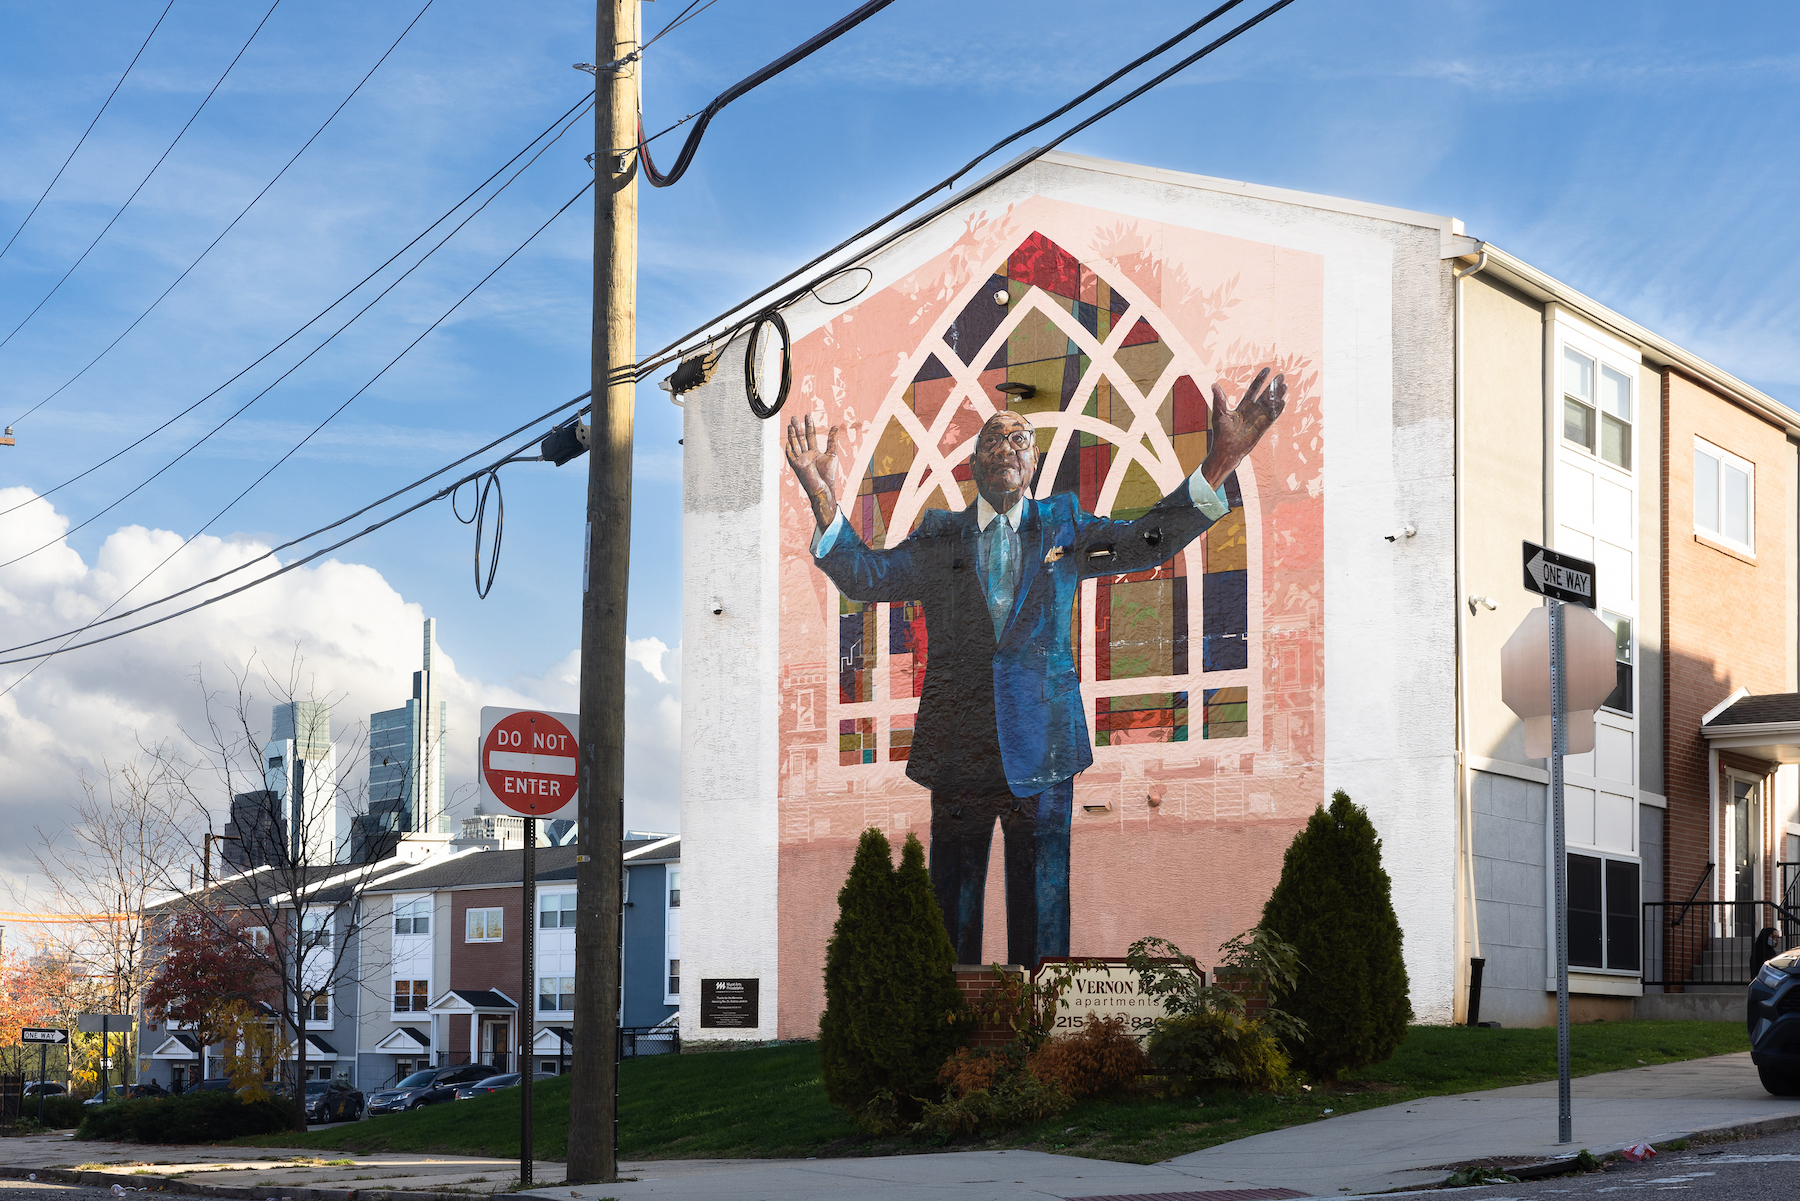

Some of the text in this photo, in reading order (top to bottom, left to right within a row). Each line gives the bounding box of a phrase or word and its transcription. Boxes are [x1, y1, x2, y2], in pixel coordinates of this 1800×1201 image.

[1543, 563, 1588, 593] ONE WAY
[497, 729, 568, 751] DO NOT
[504, 776, 561, 797] ENTER
[1075, 978, 1134, 995] VERNON
[1075, 997, 1160, 1008] apartments
[24, 1031, 55, 1040] ONE WAY
